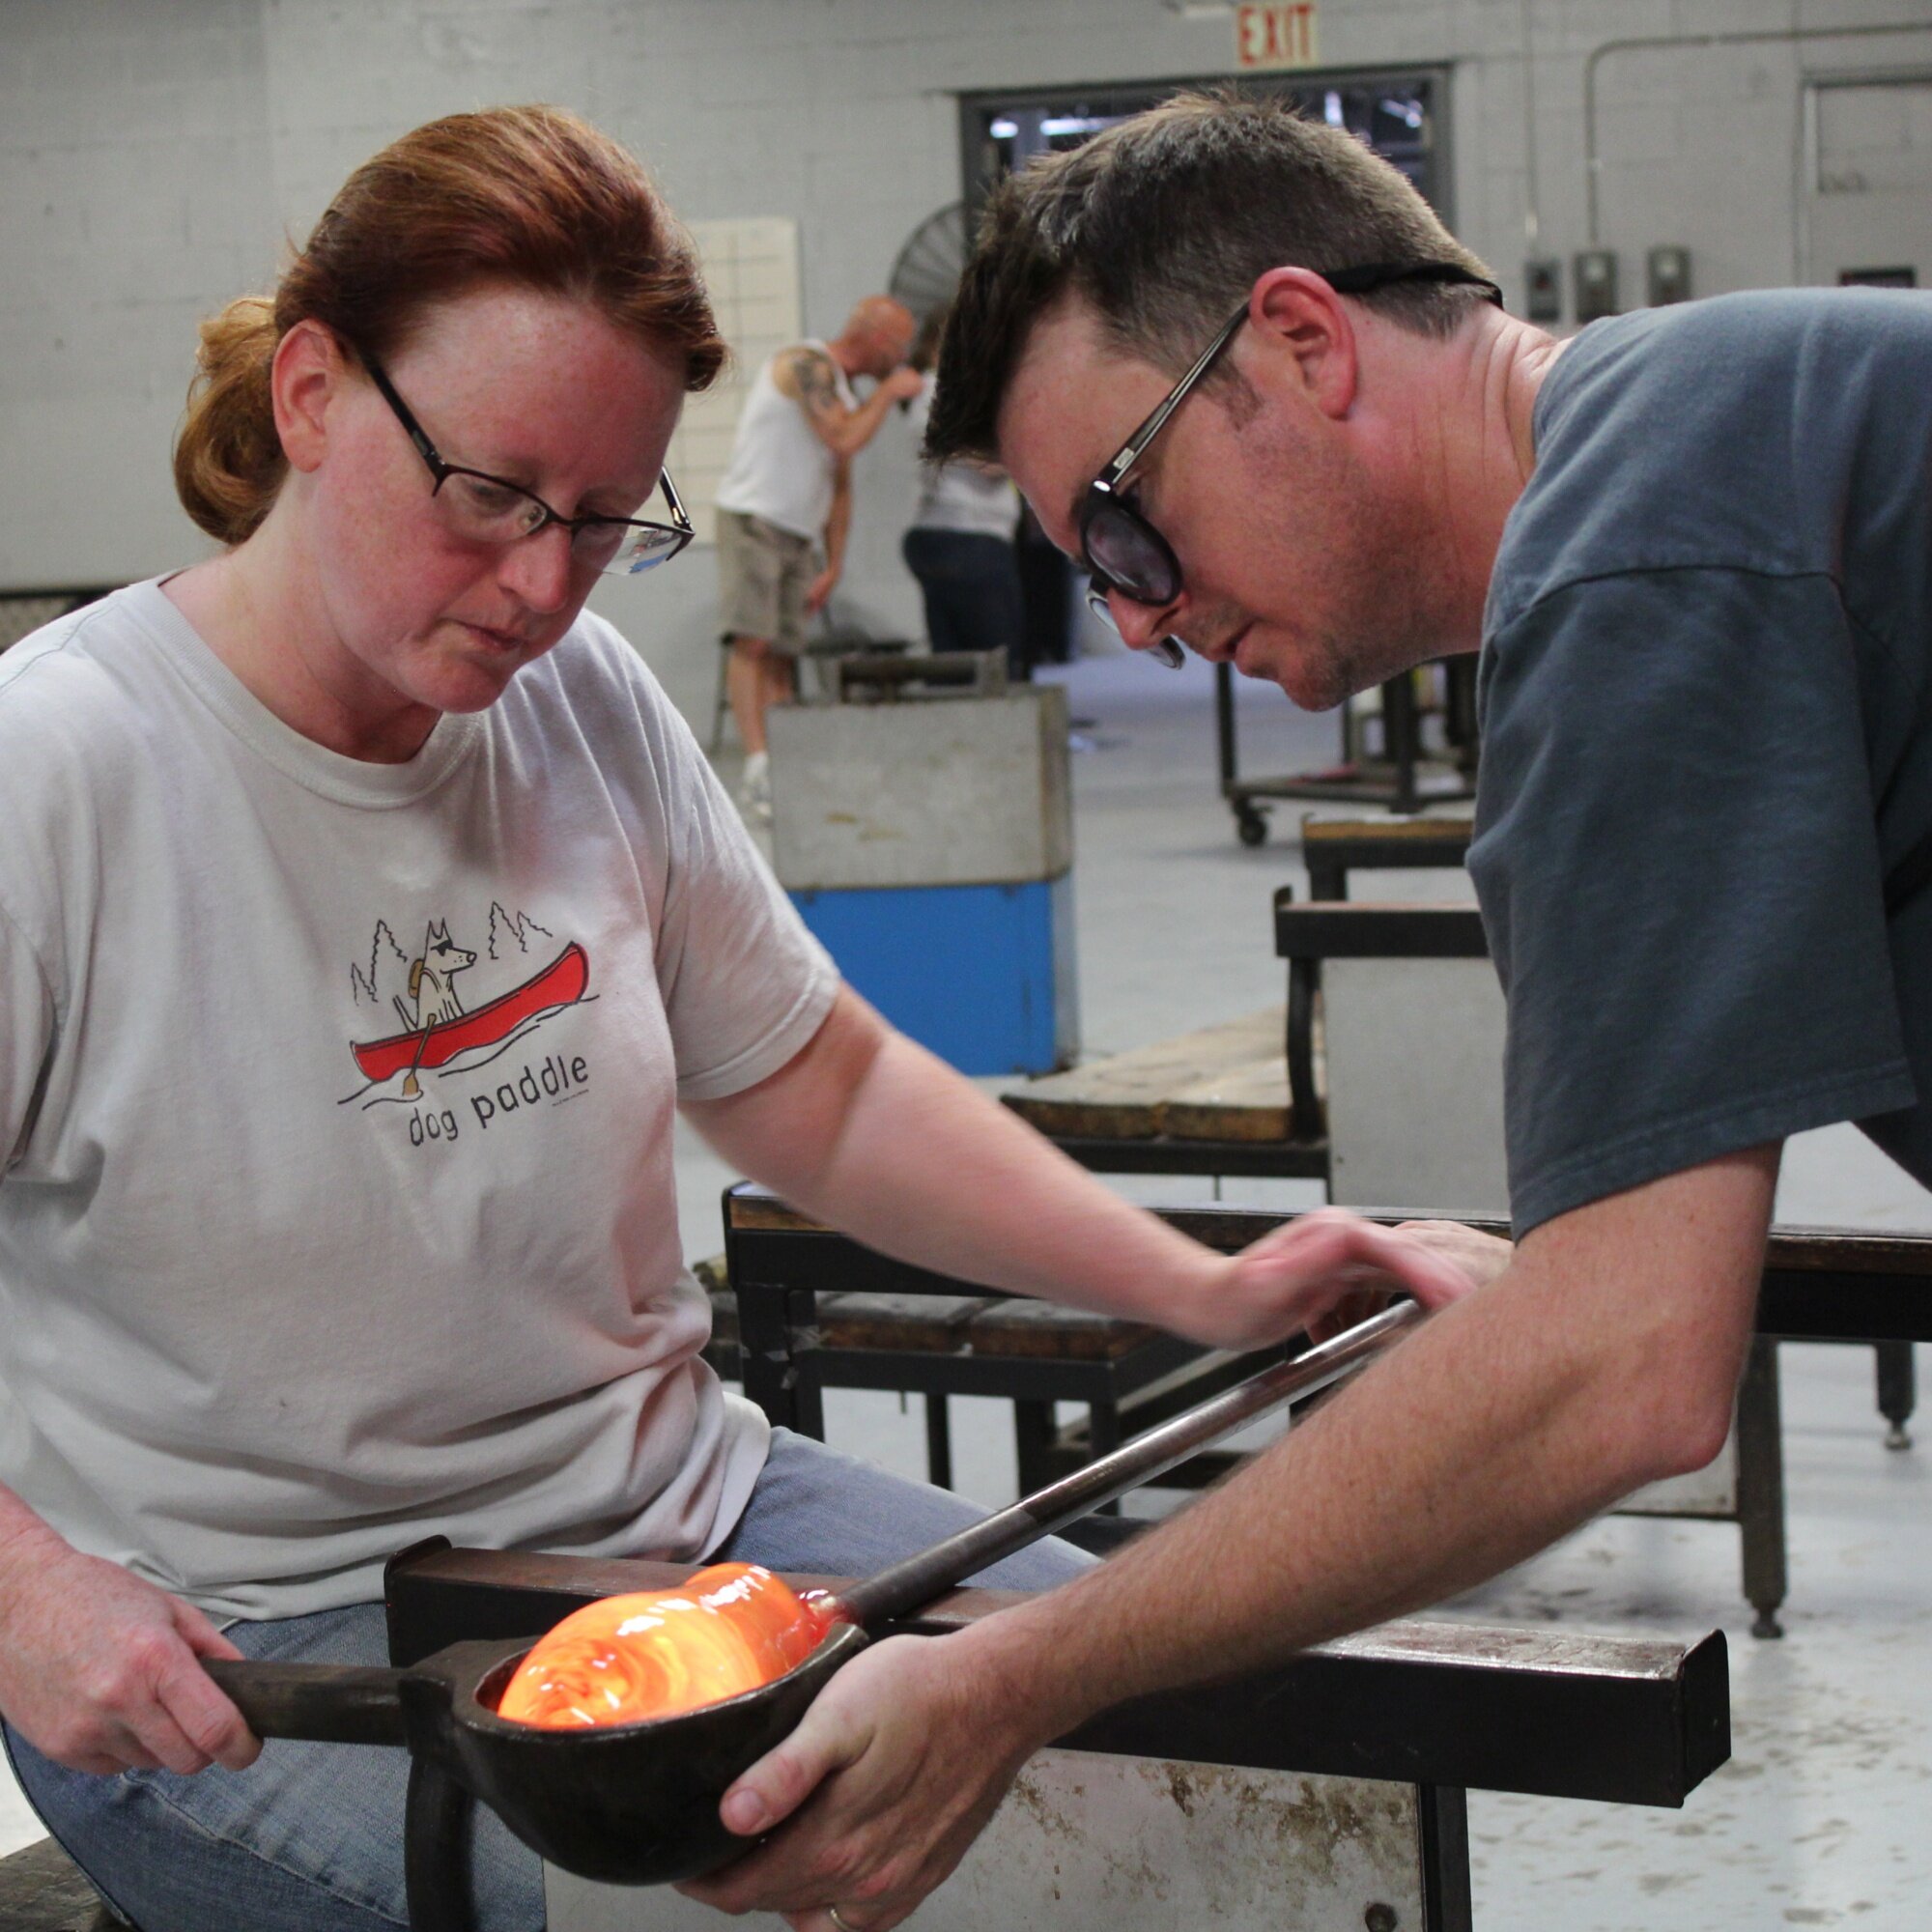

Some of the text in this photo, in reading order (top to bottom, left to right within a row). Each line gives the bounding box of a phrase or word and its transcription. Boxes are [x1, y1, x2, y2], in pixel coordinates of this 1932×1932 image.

[1238, 3, 1315, 67] EXIT
[409, 1055, 588, 1147] dog paddle
